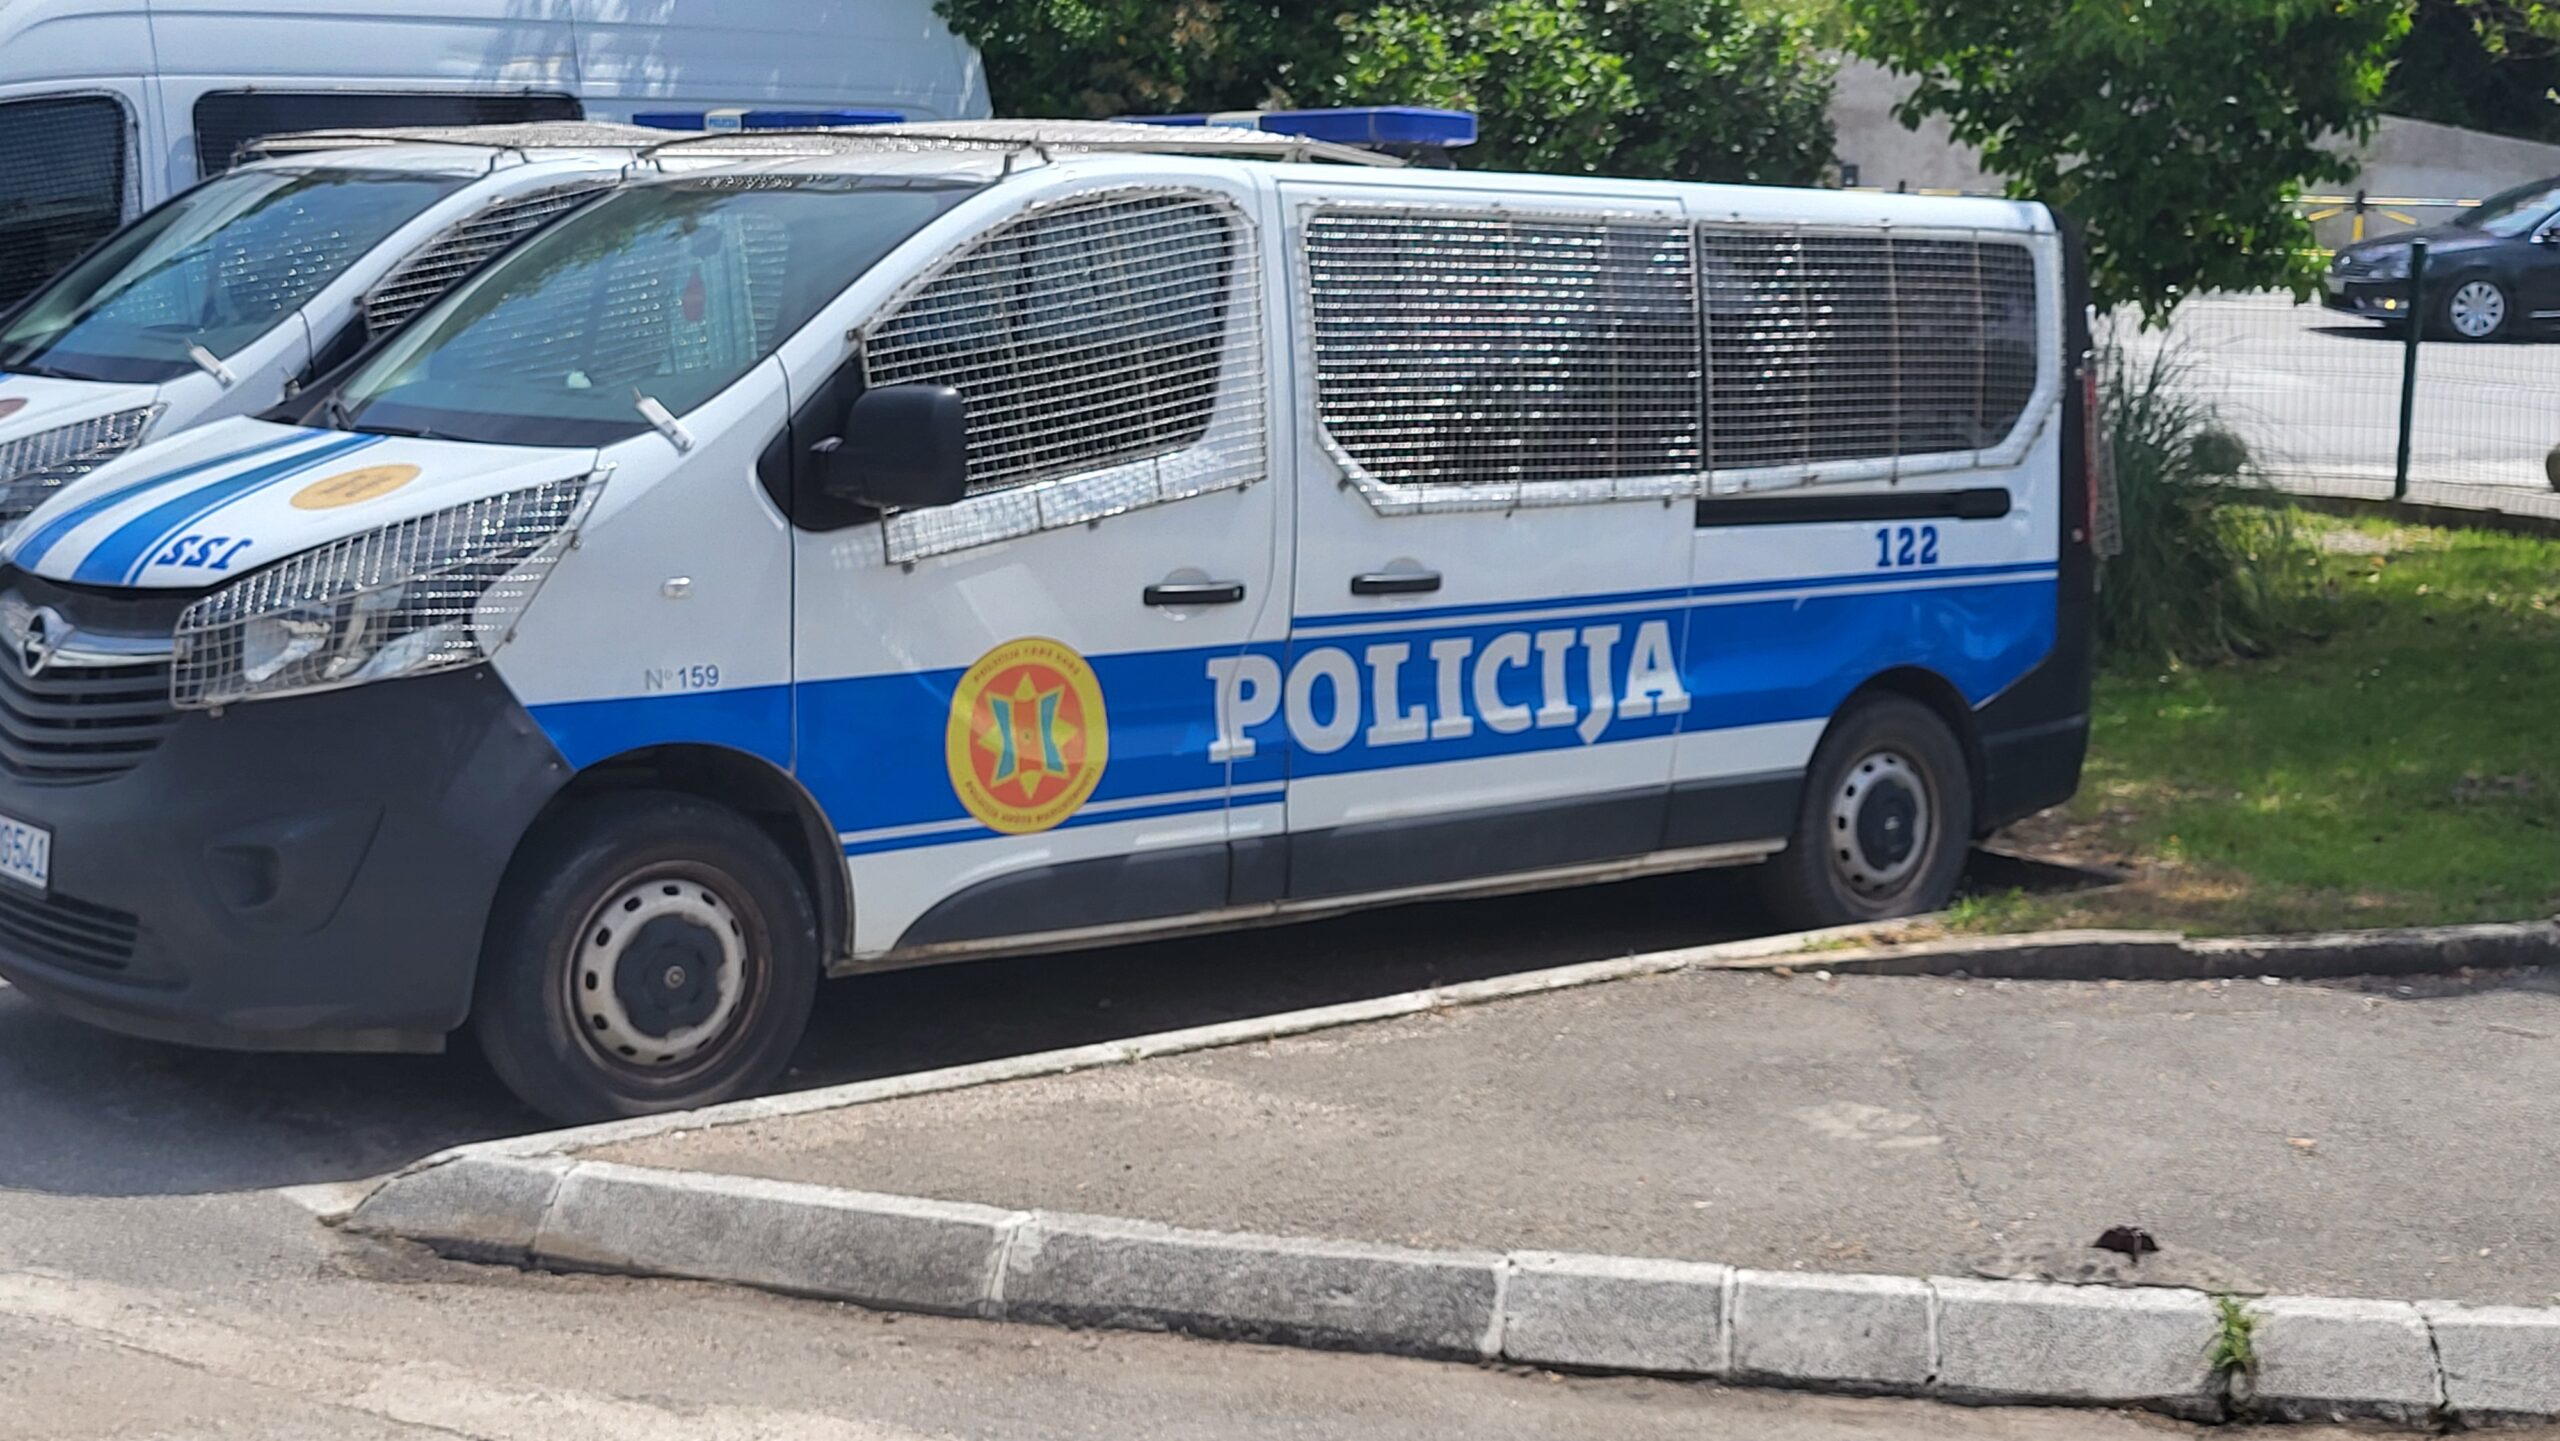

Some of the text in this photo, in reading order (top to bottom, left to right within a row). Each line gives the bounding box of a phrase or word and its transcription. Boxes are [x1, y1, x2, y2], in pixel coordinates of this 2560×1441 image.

[1876, 526, 1938, 567] 122
[677, 664, 720, 688] 159
[1206, 620, 1691, 762] POLICIJA
